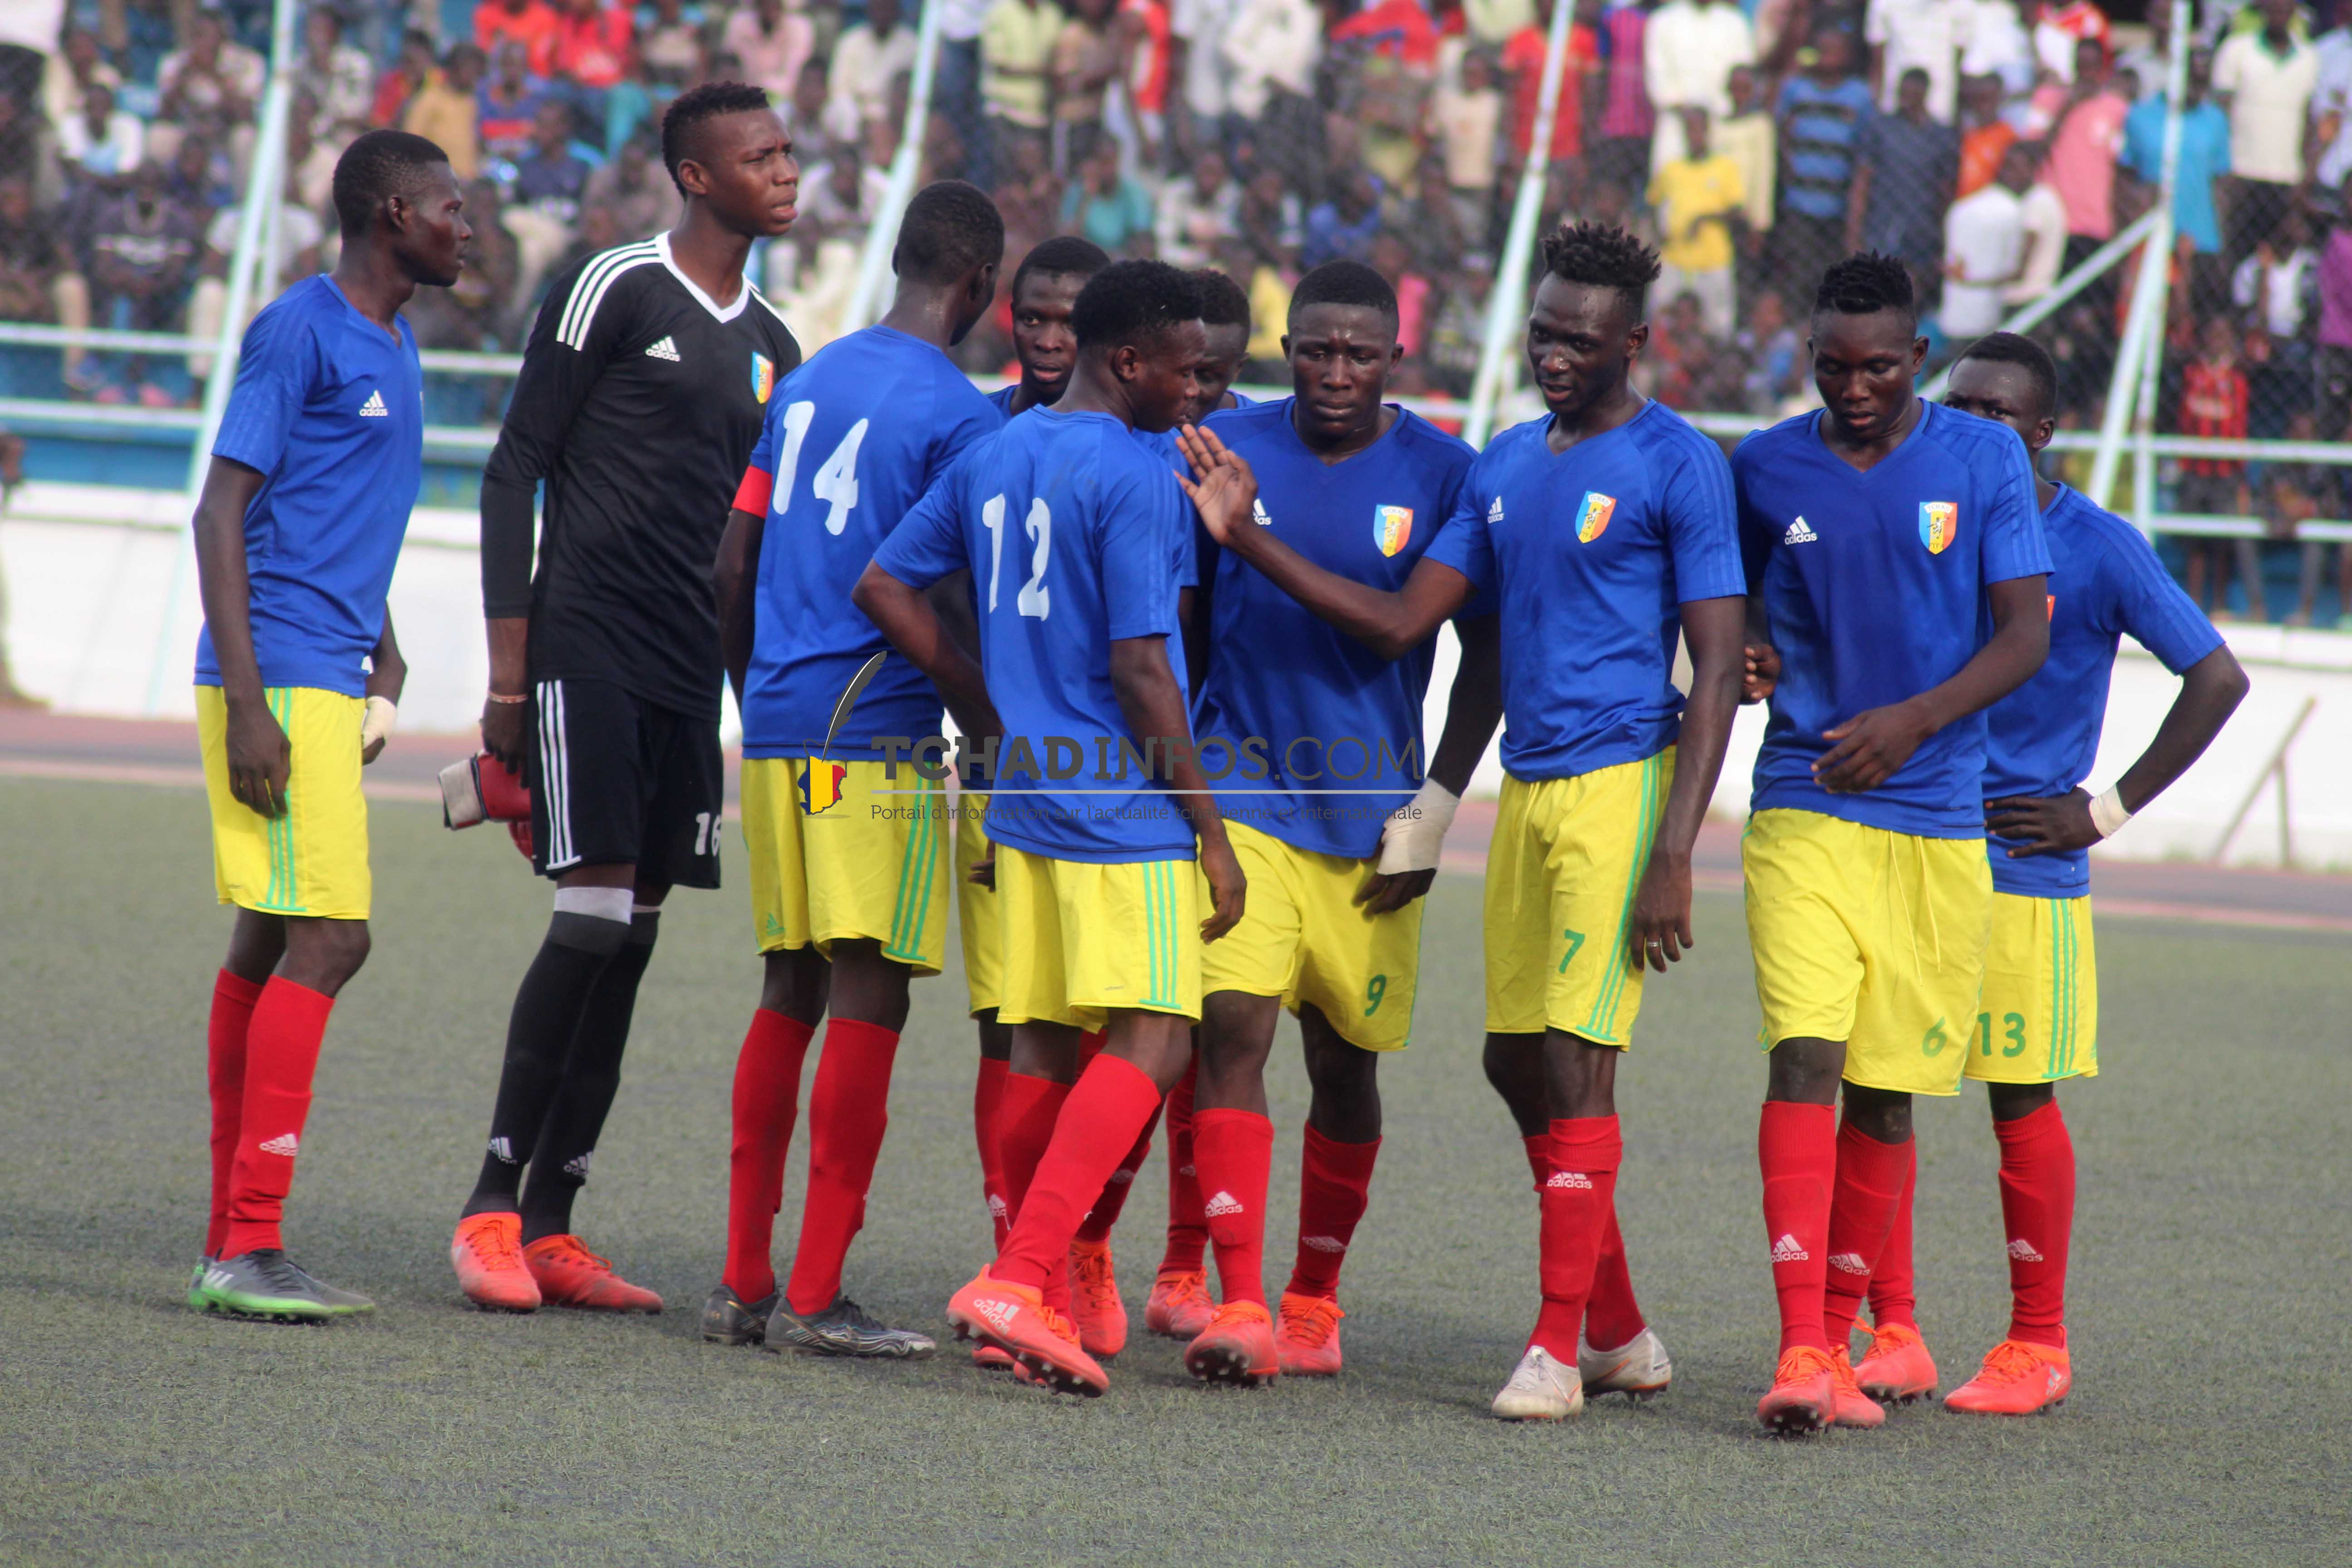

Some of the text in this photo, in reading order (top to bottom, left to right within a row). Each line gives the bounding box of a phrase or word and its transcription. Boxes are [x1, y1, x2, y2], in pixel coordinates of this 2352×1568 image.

[645, 348, 680, 362] adidas
[359, 407, 387, 416] adidas
[773, 401, 869, 536] 14
[982, 493, 1051, 622] 12
[1785, 532, 1817, 545] adidas
[695, 812, 721, 857] 16
[1558, 929, 1585, 974] 7
[1364, 975, 1387, 1017] 9
[1922, 1016, 1948, 1058] 6
[1978, 1012, 2026, 1058] 13
[1547, 1176, 1592, 1189] adidas
[1771, 1251, 1808, 1263] adidas
[1828, 1255, 1870, 1275] adidas
[974, 1299, 1009, 1335] adidas
